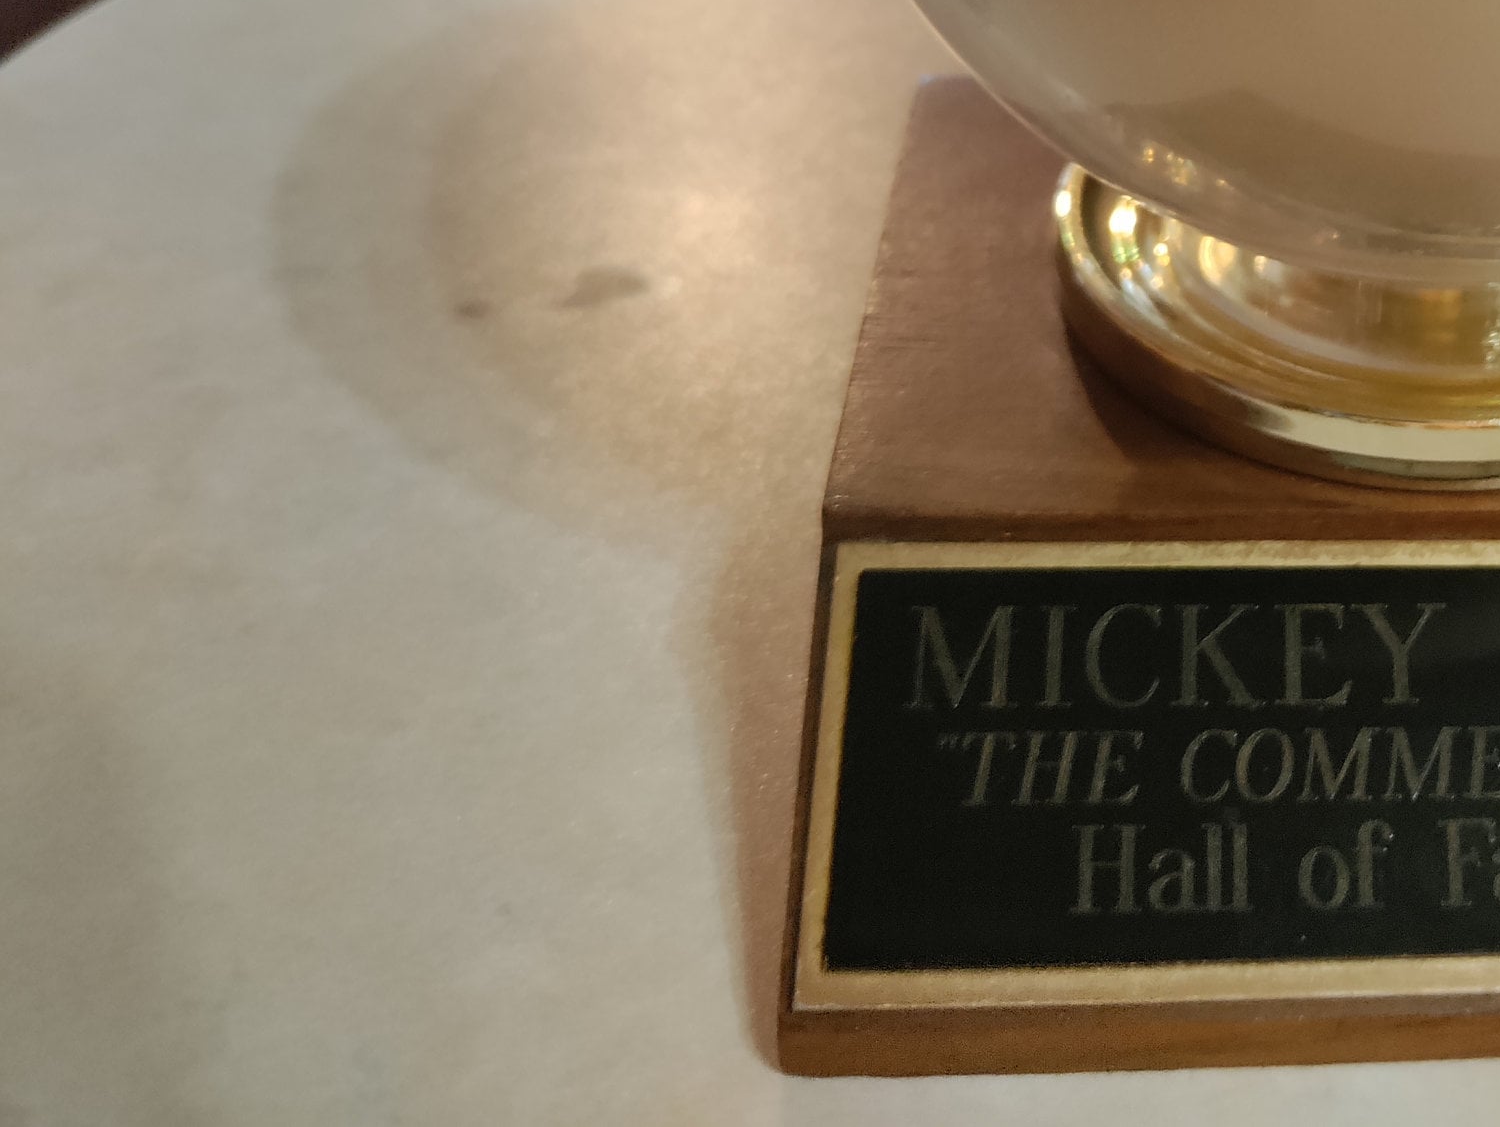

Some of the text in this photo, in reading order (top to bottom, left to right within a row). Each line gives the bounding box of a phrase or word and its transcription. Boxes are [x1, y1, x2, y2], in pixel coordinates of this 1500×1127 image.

[903, 603, 1449, 710] MICKEY
[936, 729, 1145, 806] "THE
[1069, 822, 1254, 915] Hall
[1299, 817, 1396, 910] of
